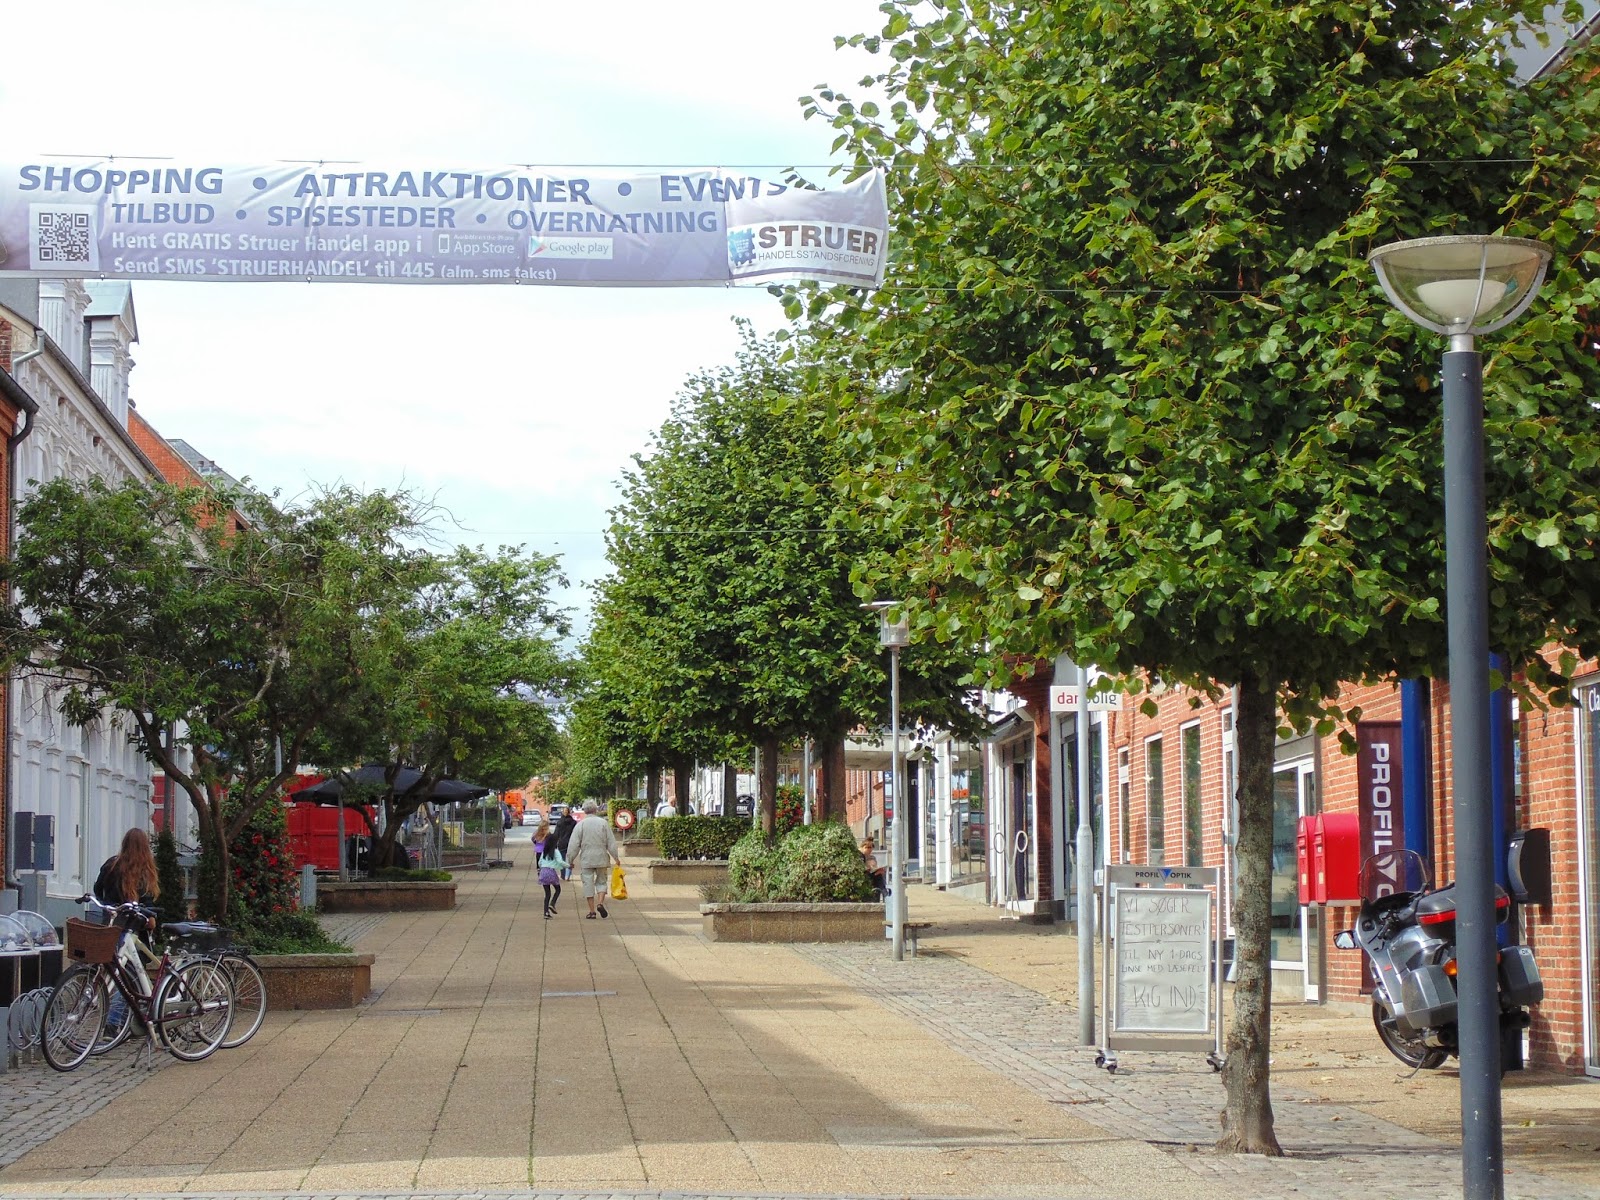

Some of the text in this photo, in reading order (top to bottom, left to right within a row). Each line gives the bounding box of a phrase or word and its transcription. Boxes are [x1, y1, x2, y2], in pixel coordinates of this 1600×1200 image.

[19, 165, 223, 195] SHOPPING
[293, 171, 593, 206] ATTRAKTIONER
[111, 203, 718, 234] TILBUD SPISESTEDER OVERNATNING
[112, 231, 422, 257] Hent GRATIS Struer Handel app i
[453, 241, 515, 256] App Store
[549, 241, 610, 256] Google play
[758, 224, 877, 255] STRUER
[114, 257, 159, 274] Send
[165, 258, 207, 275] SMS
[375, 260, 396, 277] til
[401, 261, 435, 278] 445
[441, 264, 479, 279] (alm.
[482, 266, 511, 279] sms
[515, 265, 557, 281] takst)
[758, 249, 875, 267] HANDELSSTANDSFORENING
[1370, 742, 1393, 856] PROFIL
[1135, 870, 1192, 880] PROFIL OPTIK
[1123, 896, 1192, 916] VI SØGER
[1148, 949, 1165, 960] NY
